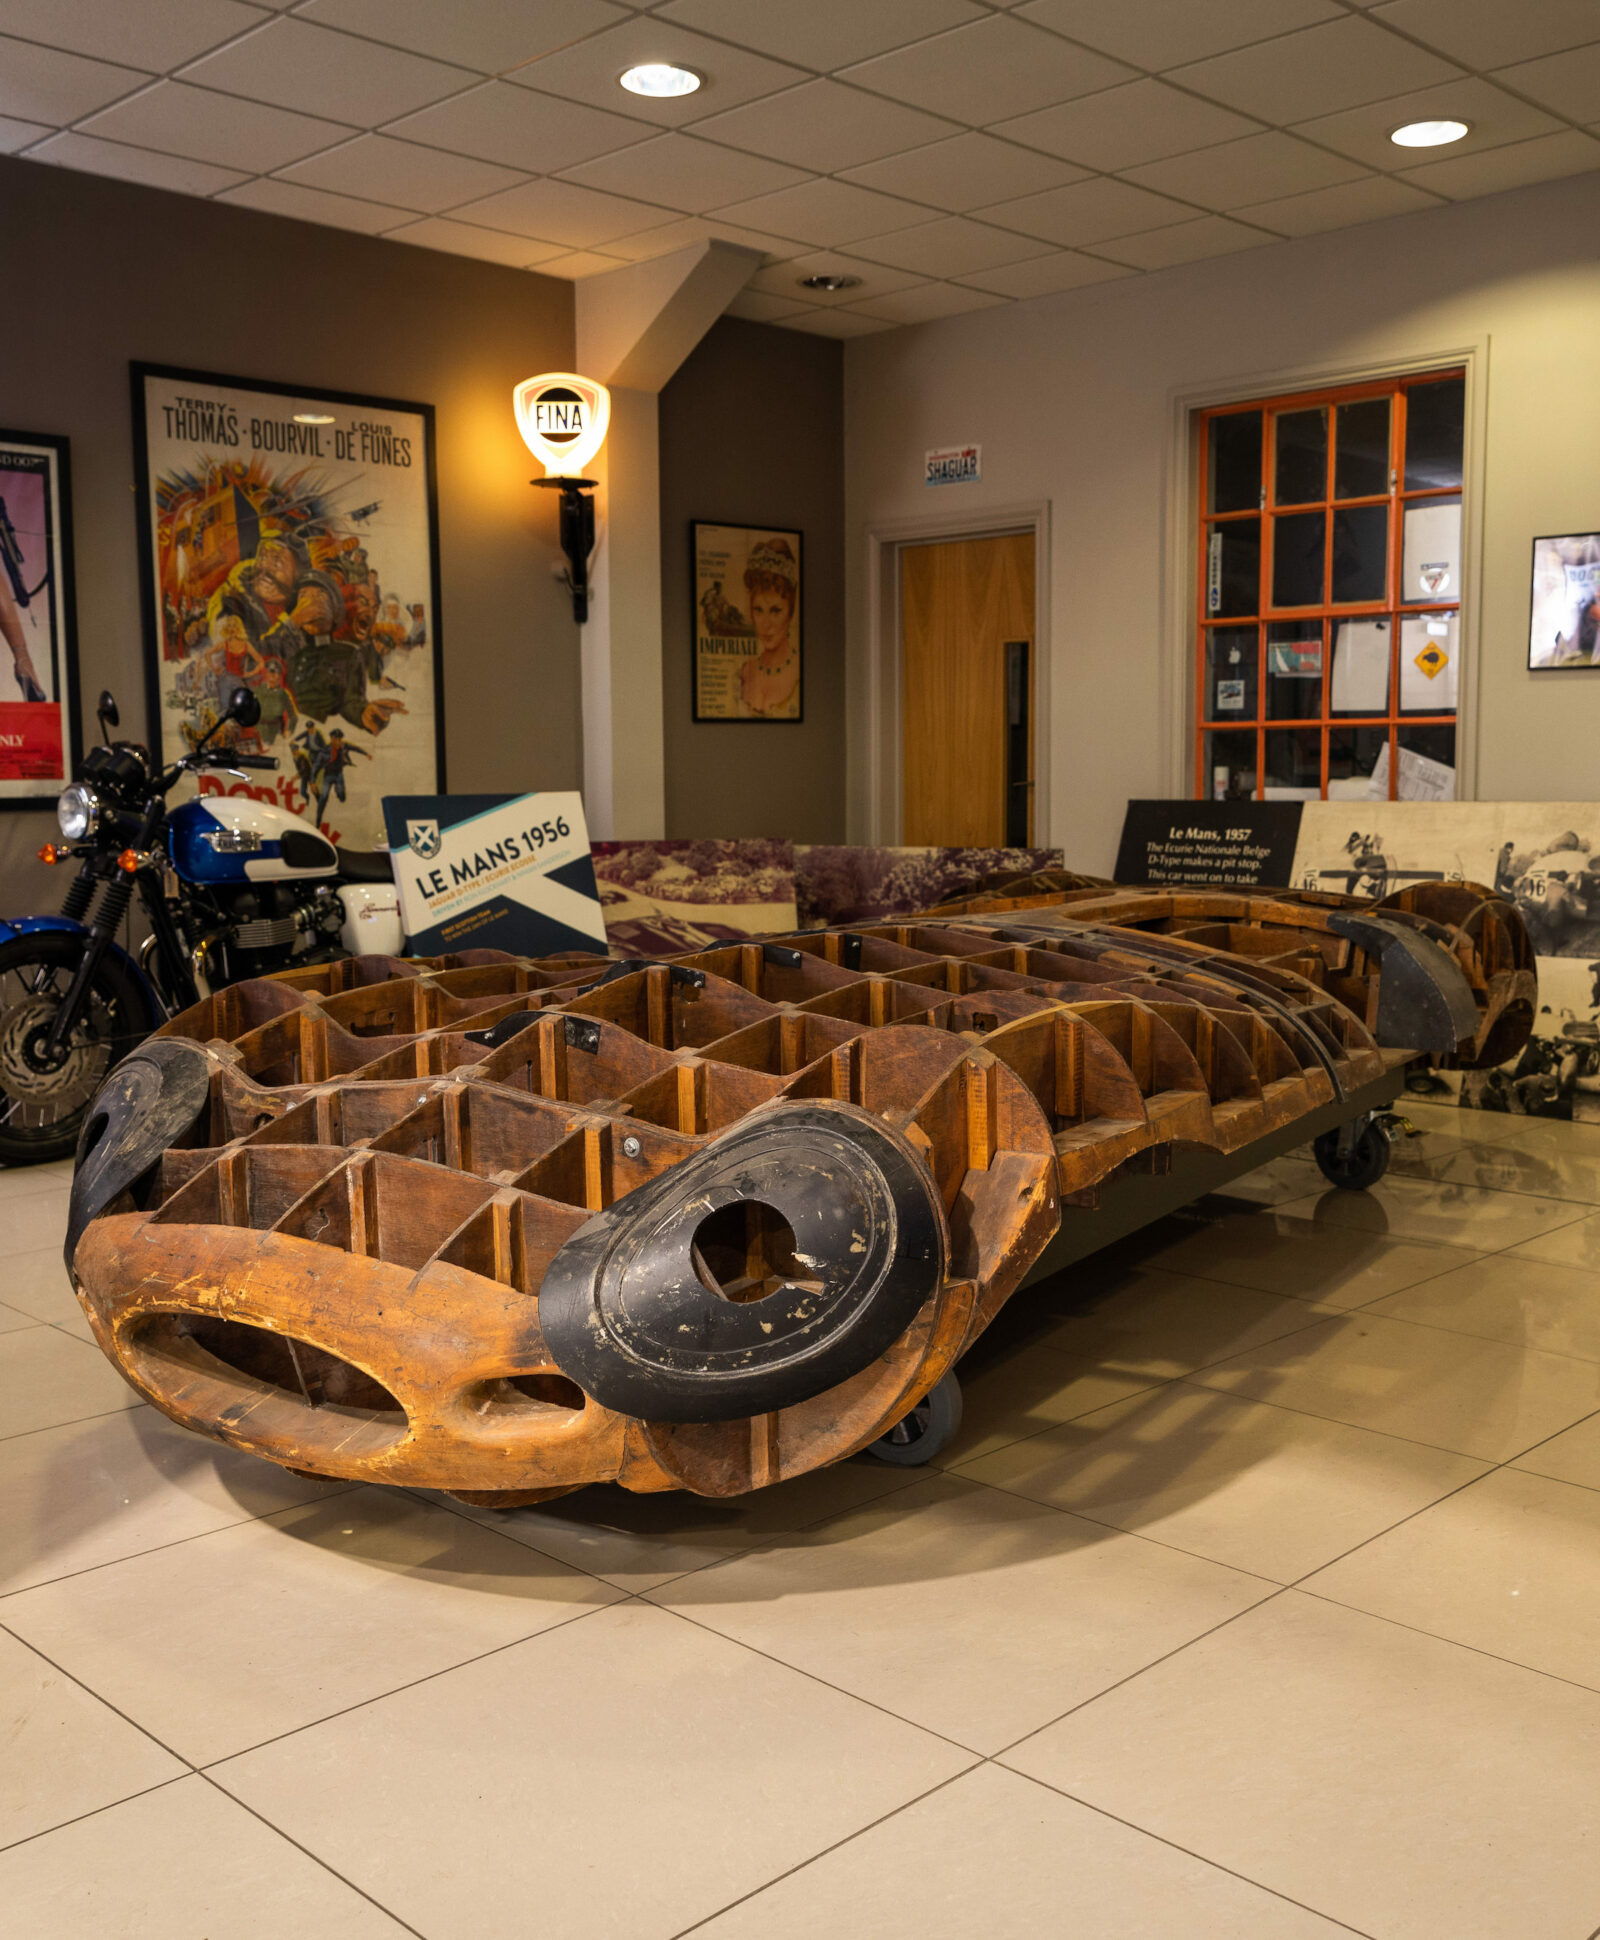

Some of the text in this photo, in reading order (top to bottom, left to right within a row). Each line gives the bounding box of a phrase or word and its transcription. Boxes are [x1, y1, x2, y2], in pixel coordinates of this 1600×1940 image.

[175, 396, 236, 412] TERRY-
[536, 405, 583, 430] FINA
[162, 405, 412, 468] THOMAS BOURVIL DE FUNES
[351, 421, 393, 436] LOUIS
[927, 455, 977, 481] SHAGUAR
[1169, 827, 1252, 841] Le Mans, 1957
[416, 869, 448, 900] LE
[450, 837, 520, 885] MANS
[521, 815, 570, 851] 1956
[1147, 842, 1271, 859] The Ecurie Nationale Belge
[1148, 854, 1182, 867] D-Type
[1183, 857, 1213, 867] makes
[1214, 859, 1221, 867] a
[1222, 858, 1236, 871] pit
[1148, 869, 1259, 884] This car went on to take
